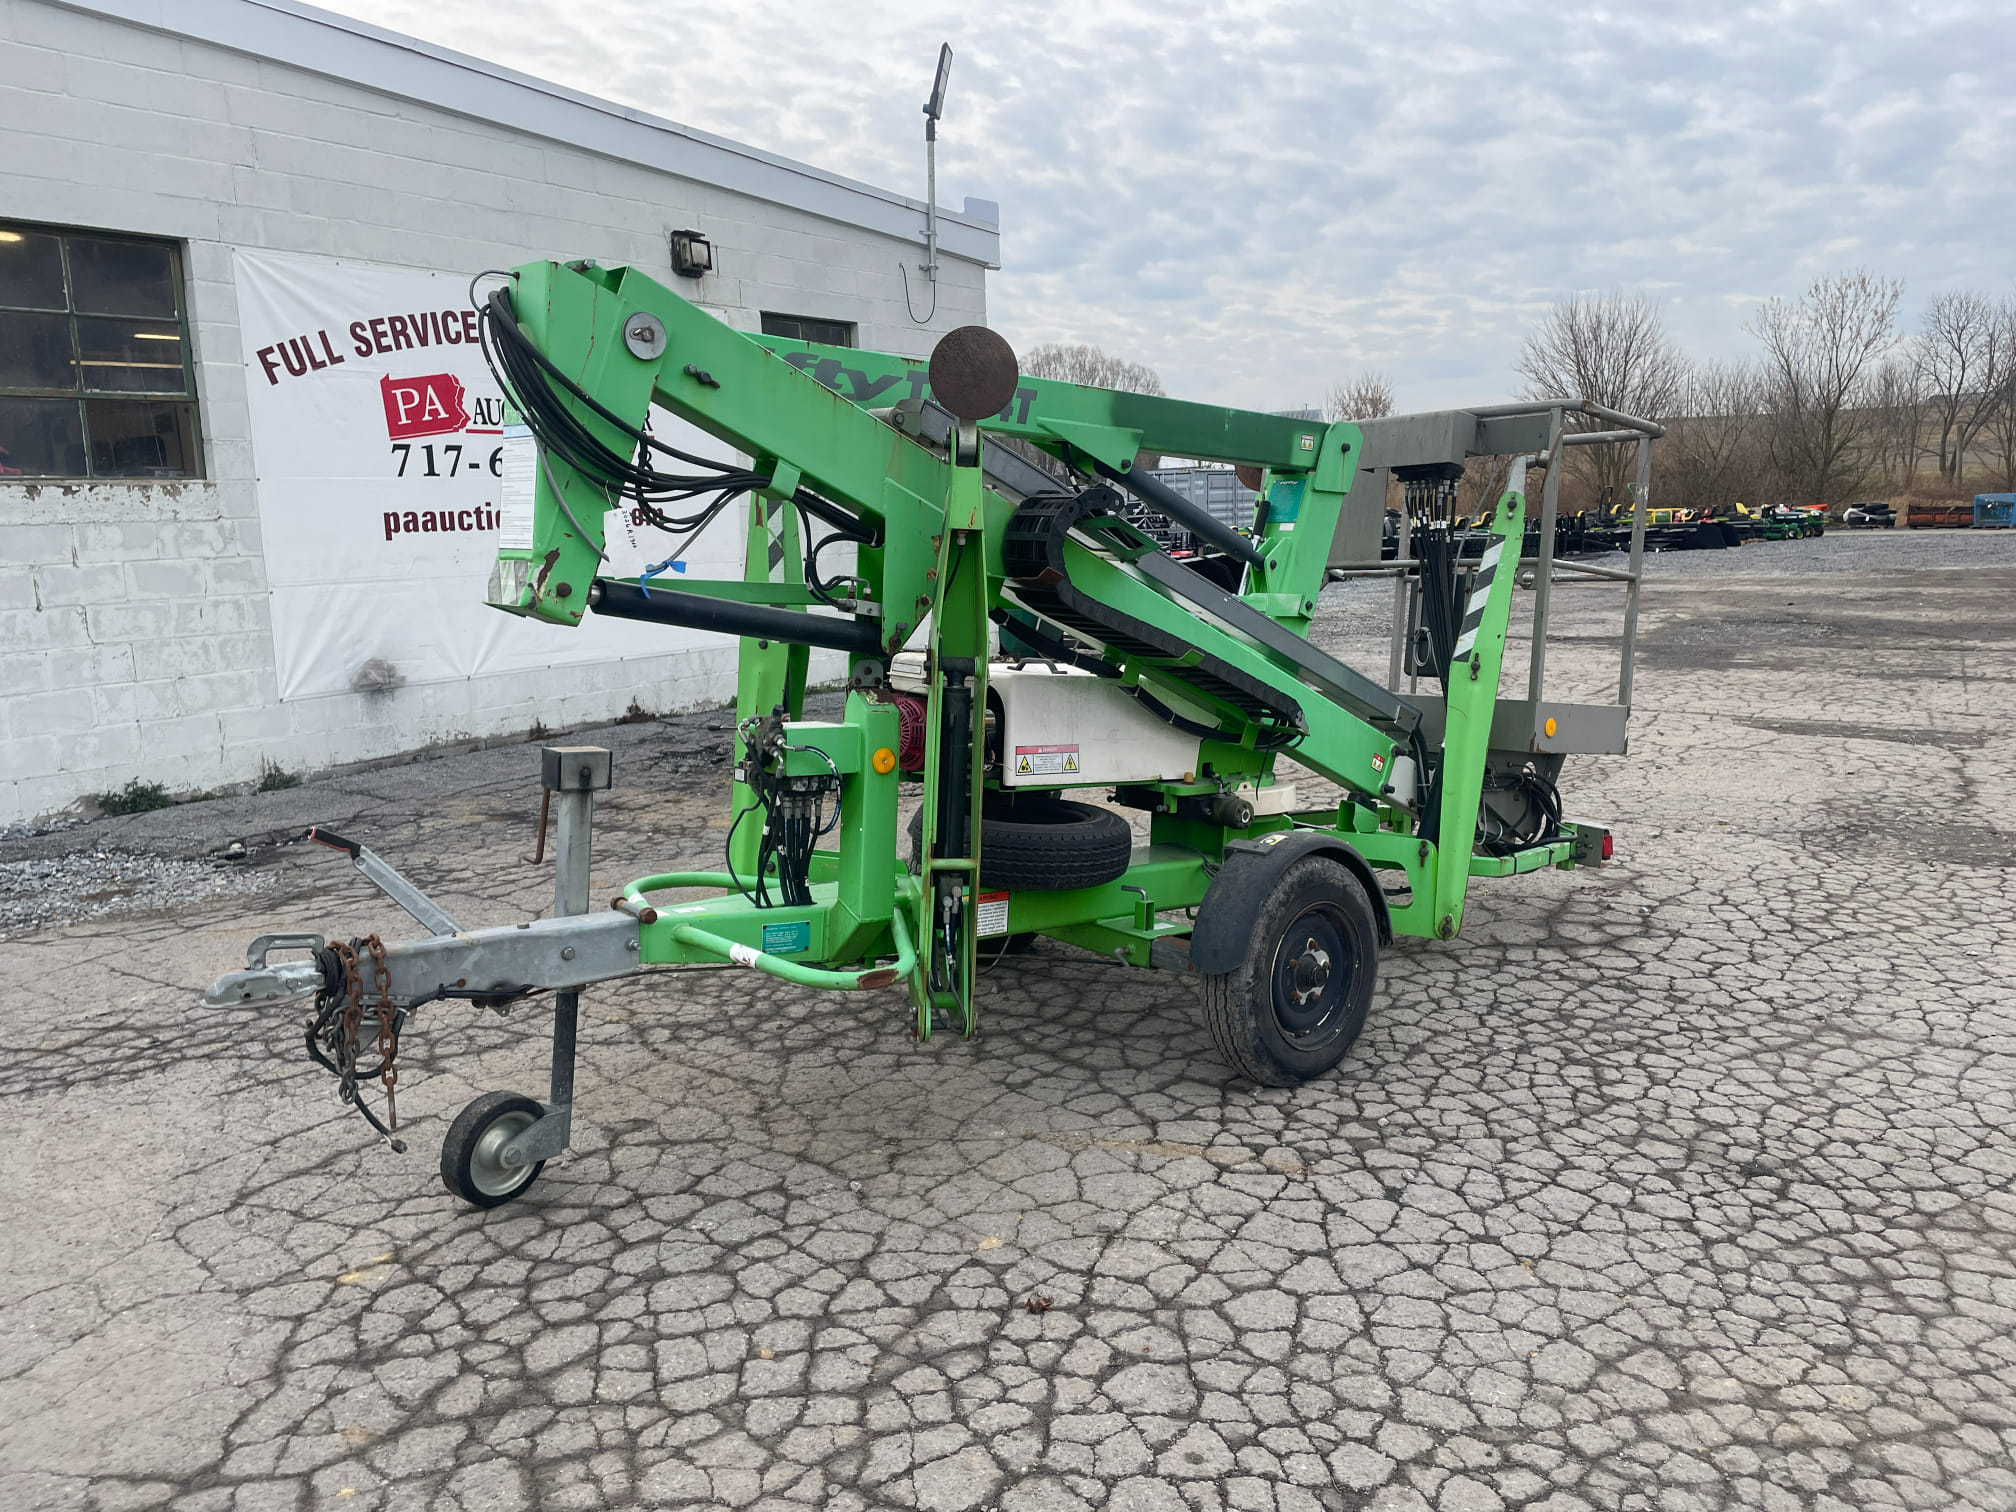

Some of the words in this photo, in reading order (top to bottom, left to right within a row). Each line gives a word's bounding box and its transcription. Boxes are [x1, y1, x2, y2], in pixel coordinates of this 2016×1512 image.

[256, 330, 345, 386] FULL
[350, 310, 481, 358] SERVICE
[391, 384, 450, 425] PA
[473, 397, 505, 426] AU
[383, 502, 501, 541] paaucti
